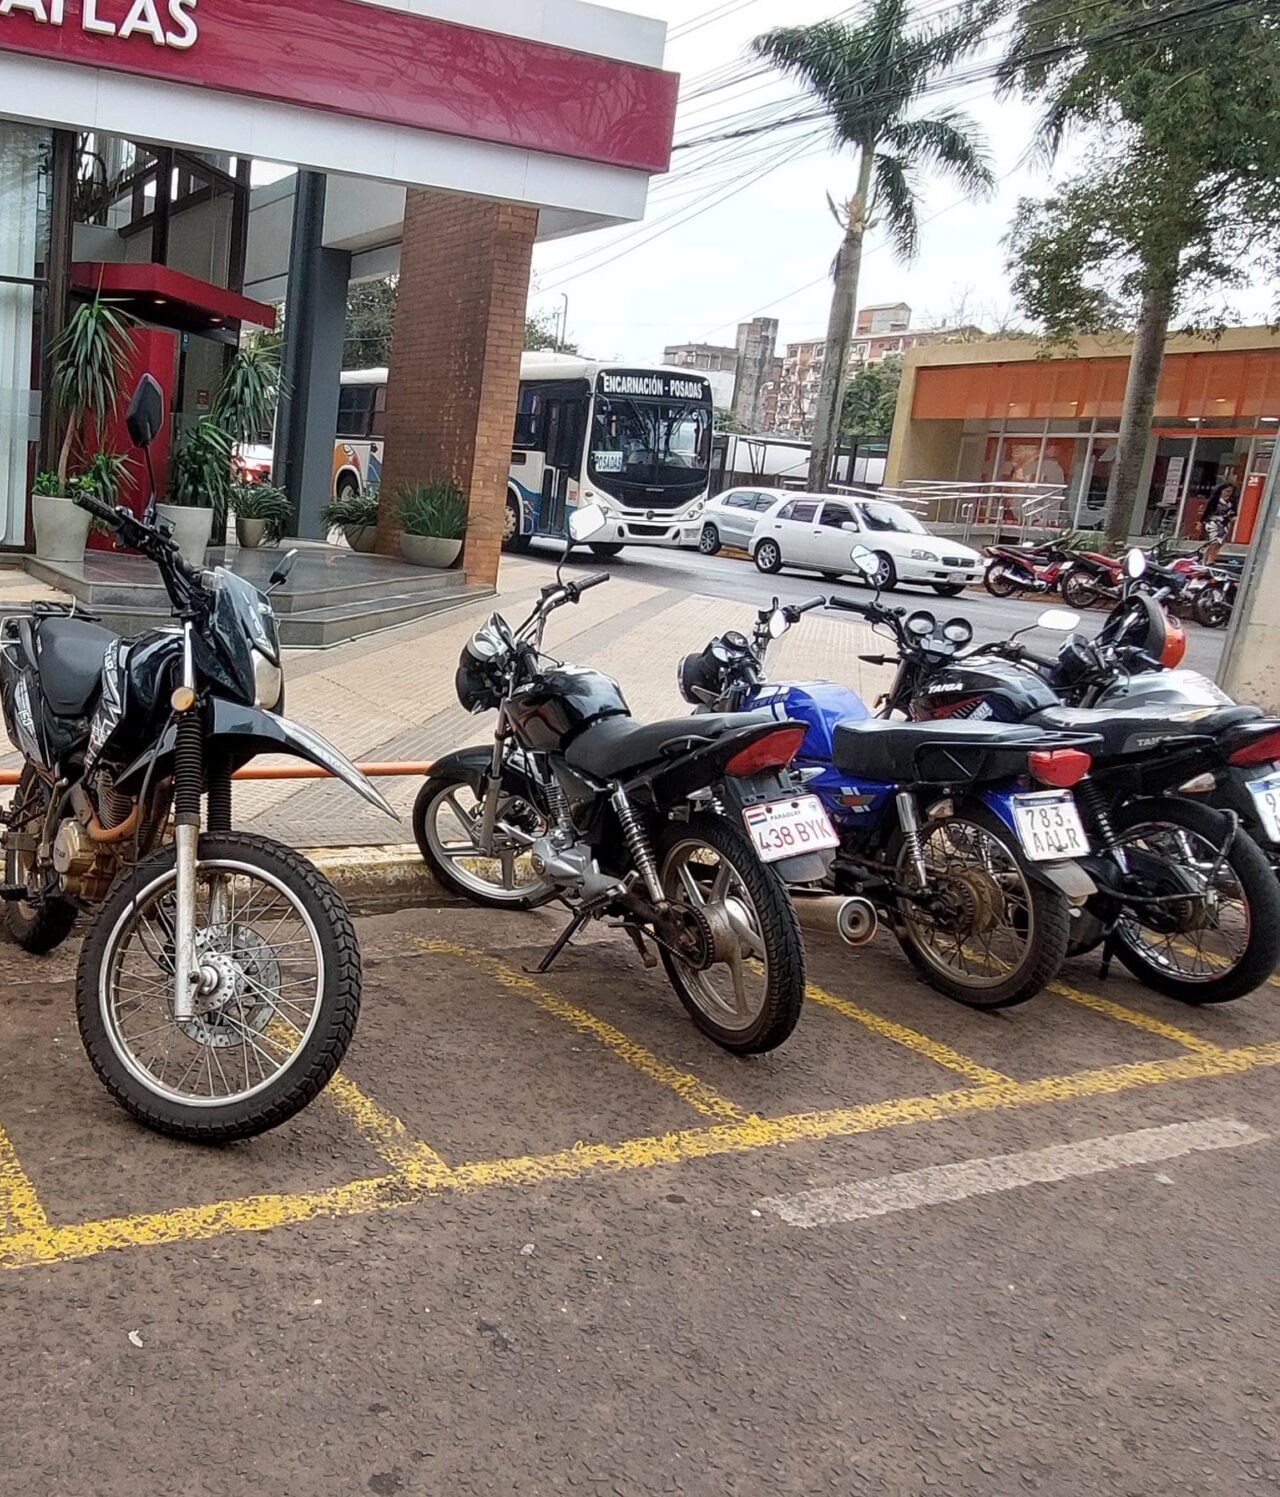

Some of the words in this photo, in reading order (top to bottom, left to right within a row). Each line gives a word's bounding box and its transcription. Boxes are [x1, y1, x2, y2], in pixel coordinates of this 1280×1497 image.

[603, 374, 663, 396] ENCARNACIÓN
[670, 380, 703, 399] POSADAS
[928, 682, 963, 694] TAIGA
[1026, 806, 1063, 830] 783
[758, 826, 795, 850] 438
[794, 818, 832, 843] BYK
[1033, 828, 1081, 852] AALR
